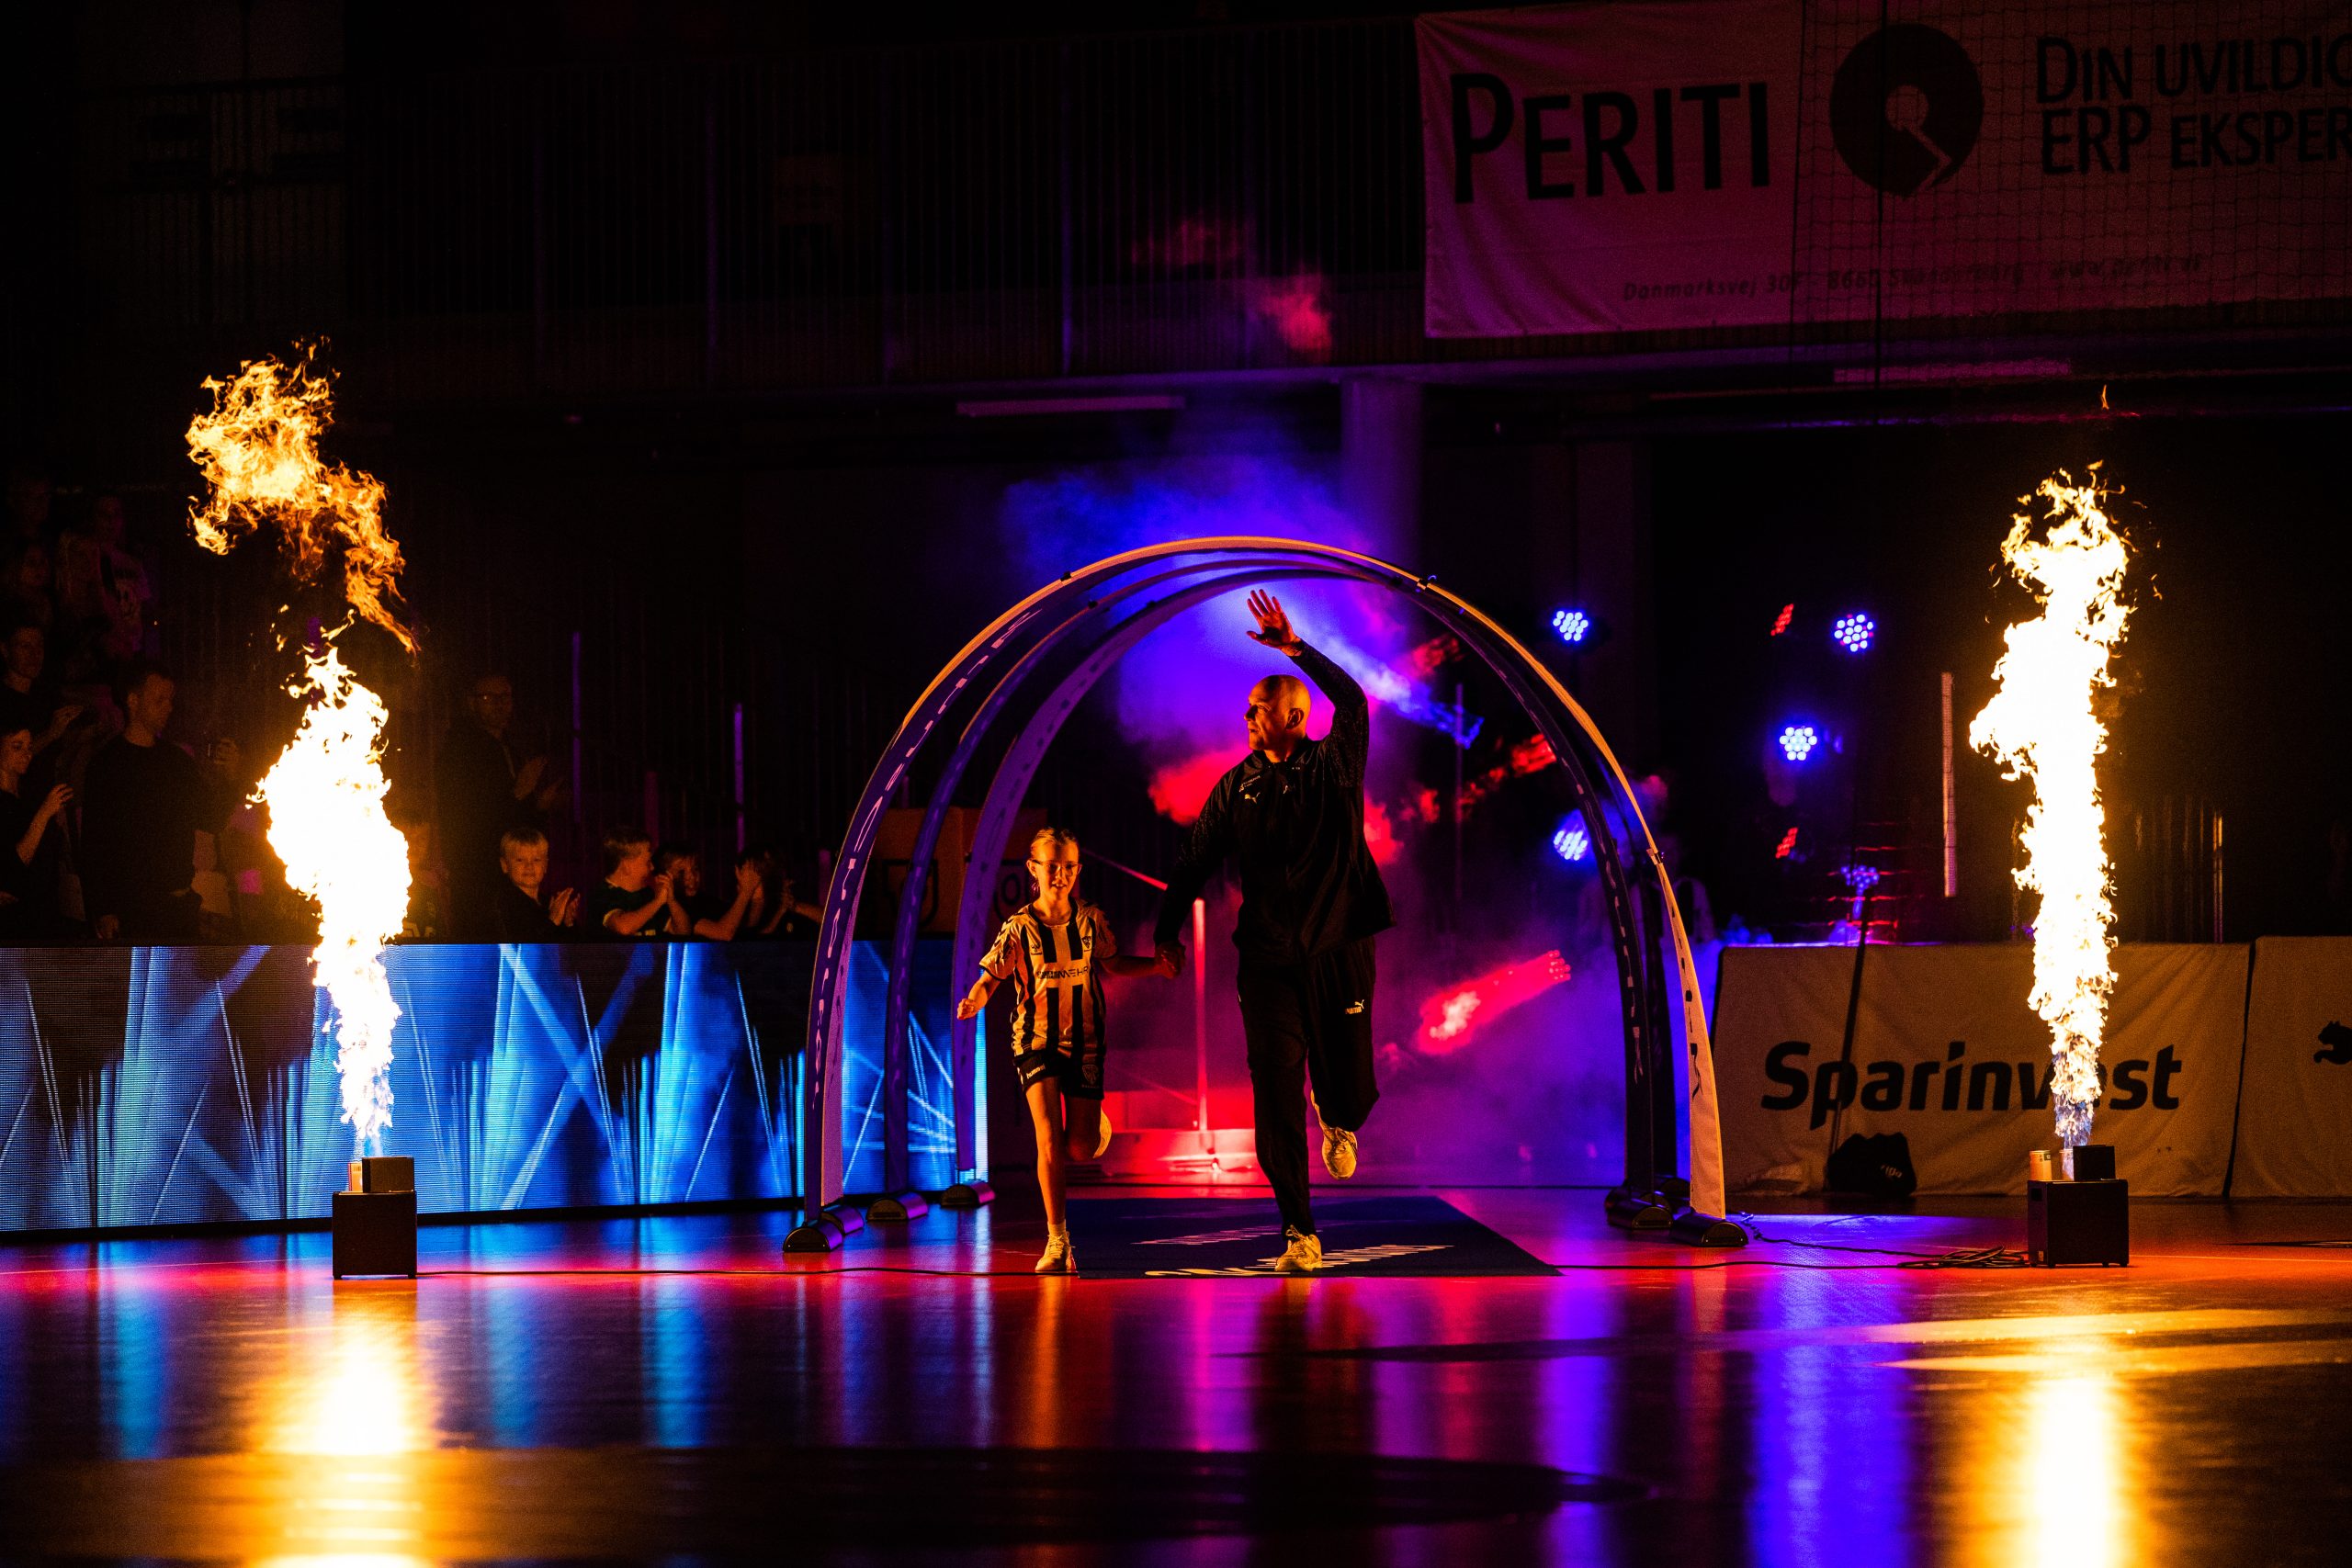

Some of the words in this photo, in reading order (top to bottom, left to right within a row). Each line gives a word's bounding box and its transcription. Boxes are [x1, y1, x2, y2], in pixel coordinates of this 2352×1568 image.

[1450, 73, 1770, 203] PERITI
[2042, 105, 2151, 174] ERP
[2171, 106, 2352, 168] EKSPER
[1623, 276, 1758, 301] Danmarksvej
[1761, 1041, 2181, 1129] Sparinvst
